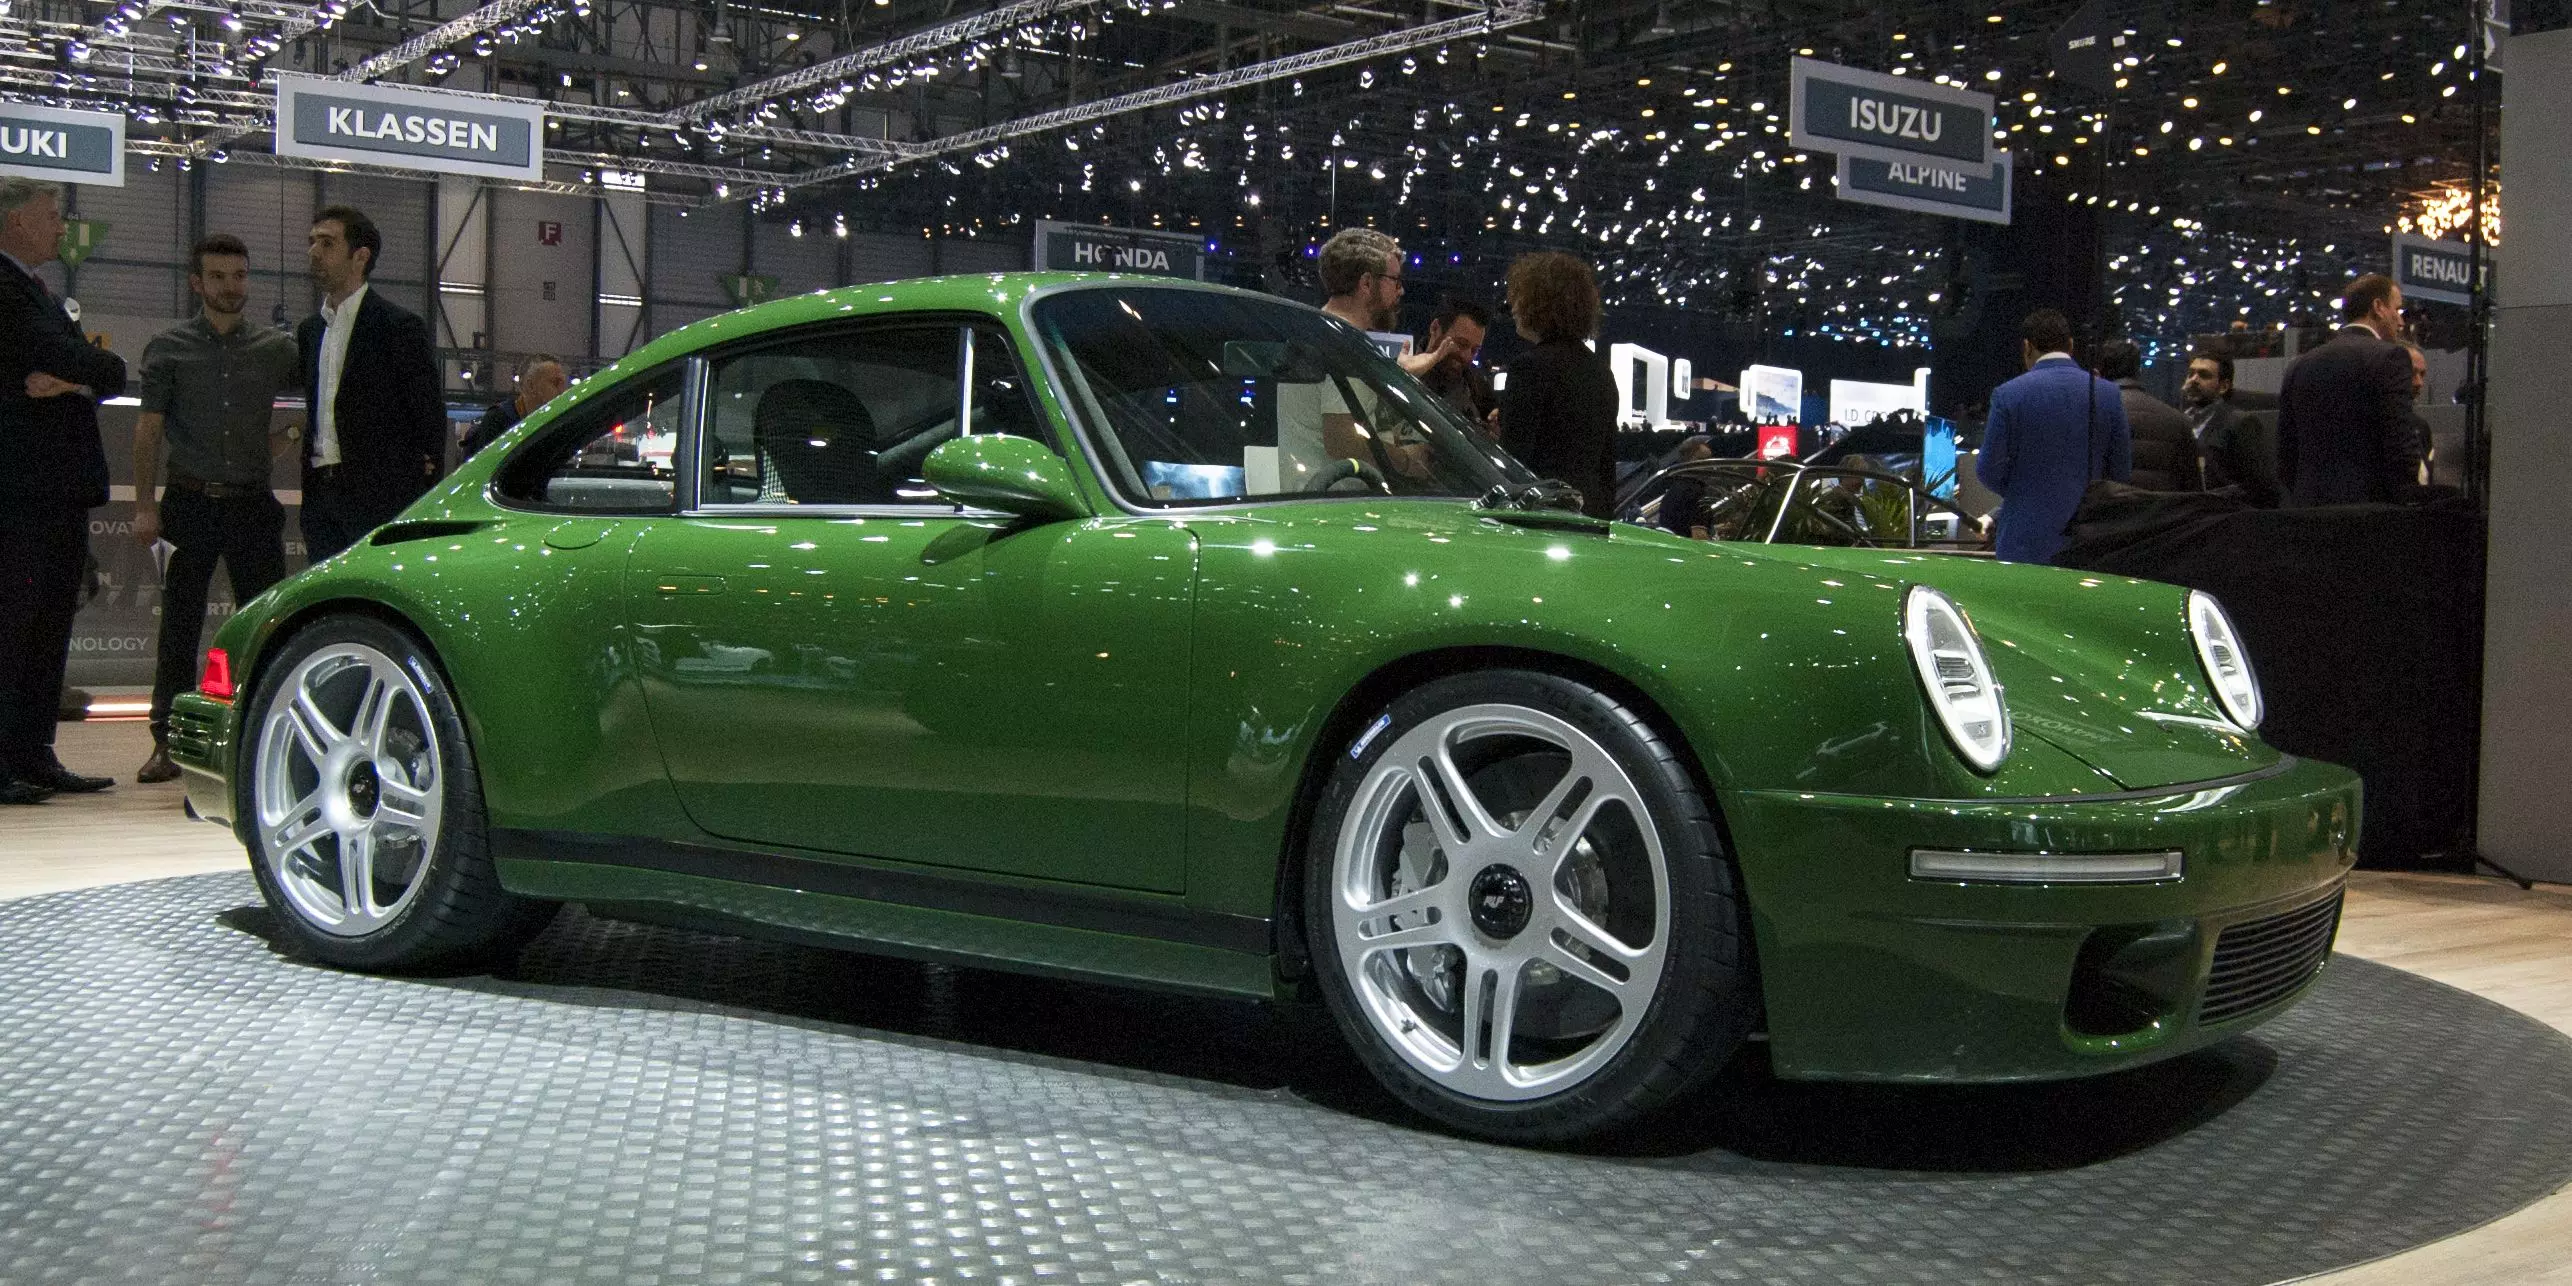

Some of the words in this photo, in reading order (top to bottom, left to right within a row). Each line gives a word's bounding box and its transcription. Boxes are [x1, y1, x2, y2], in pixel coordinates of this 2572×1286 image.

[329, 106, 498, 152] KLASSEN
[1851, 97, 1942, 142] ISUZU
[1, 126, 67, 159] UKI
[1888, 162, 1968, 192] ALPINE
[2411, 254, 2488, 288] RENAUT
[68, 636, 150, 652] NOLOGY
